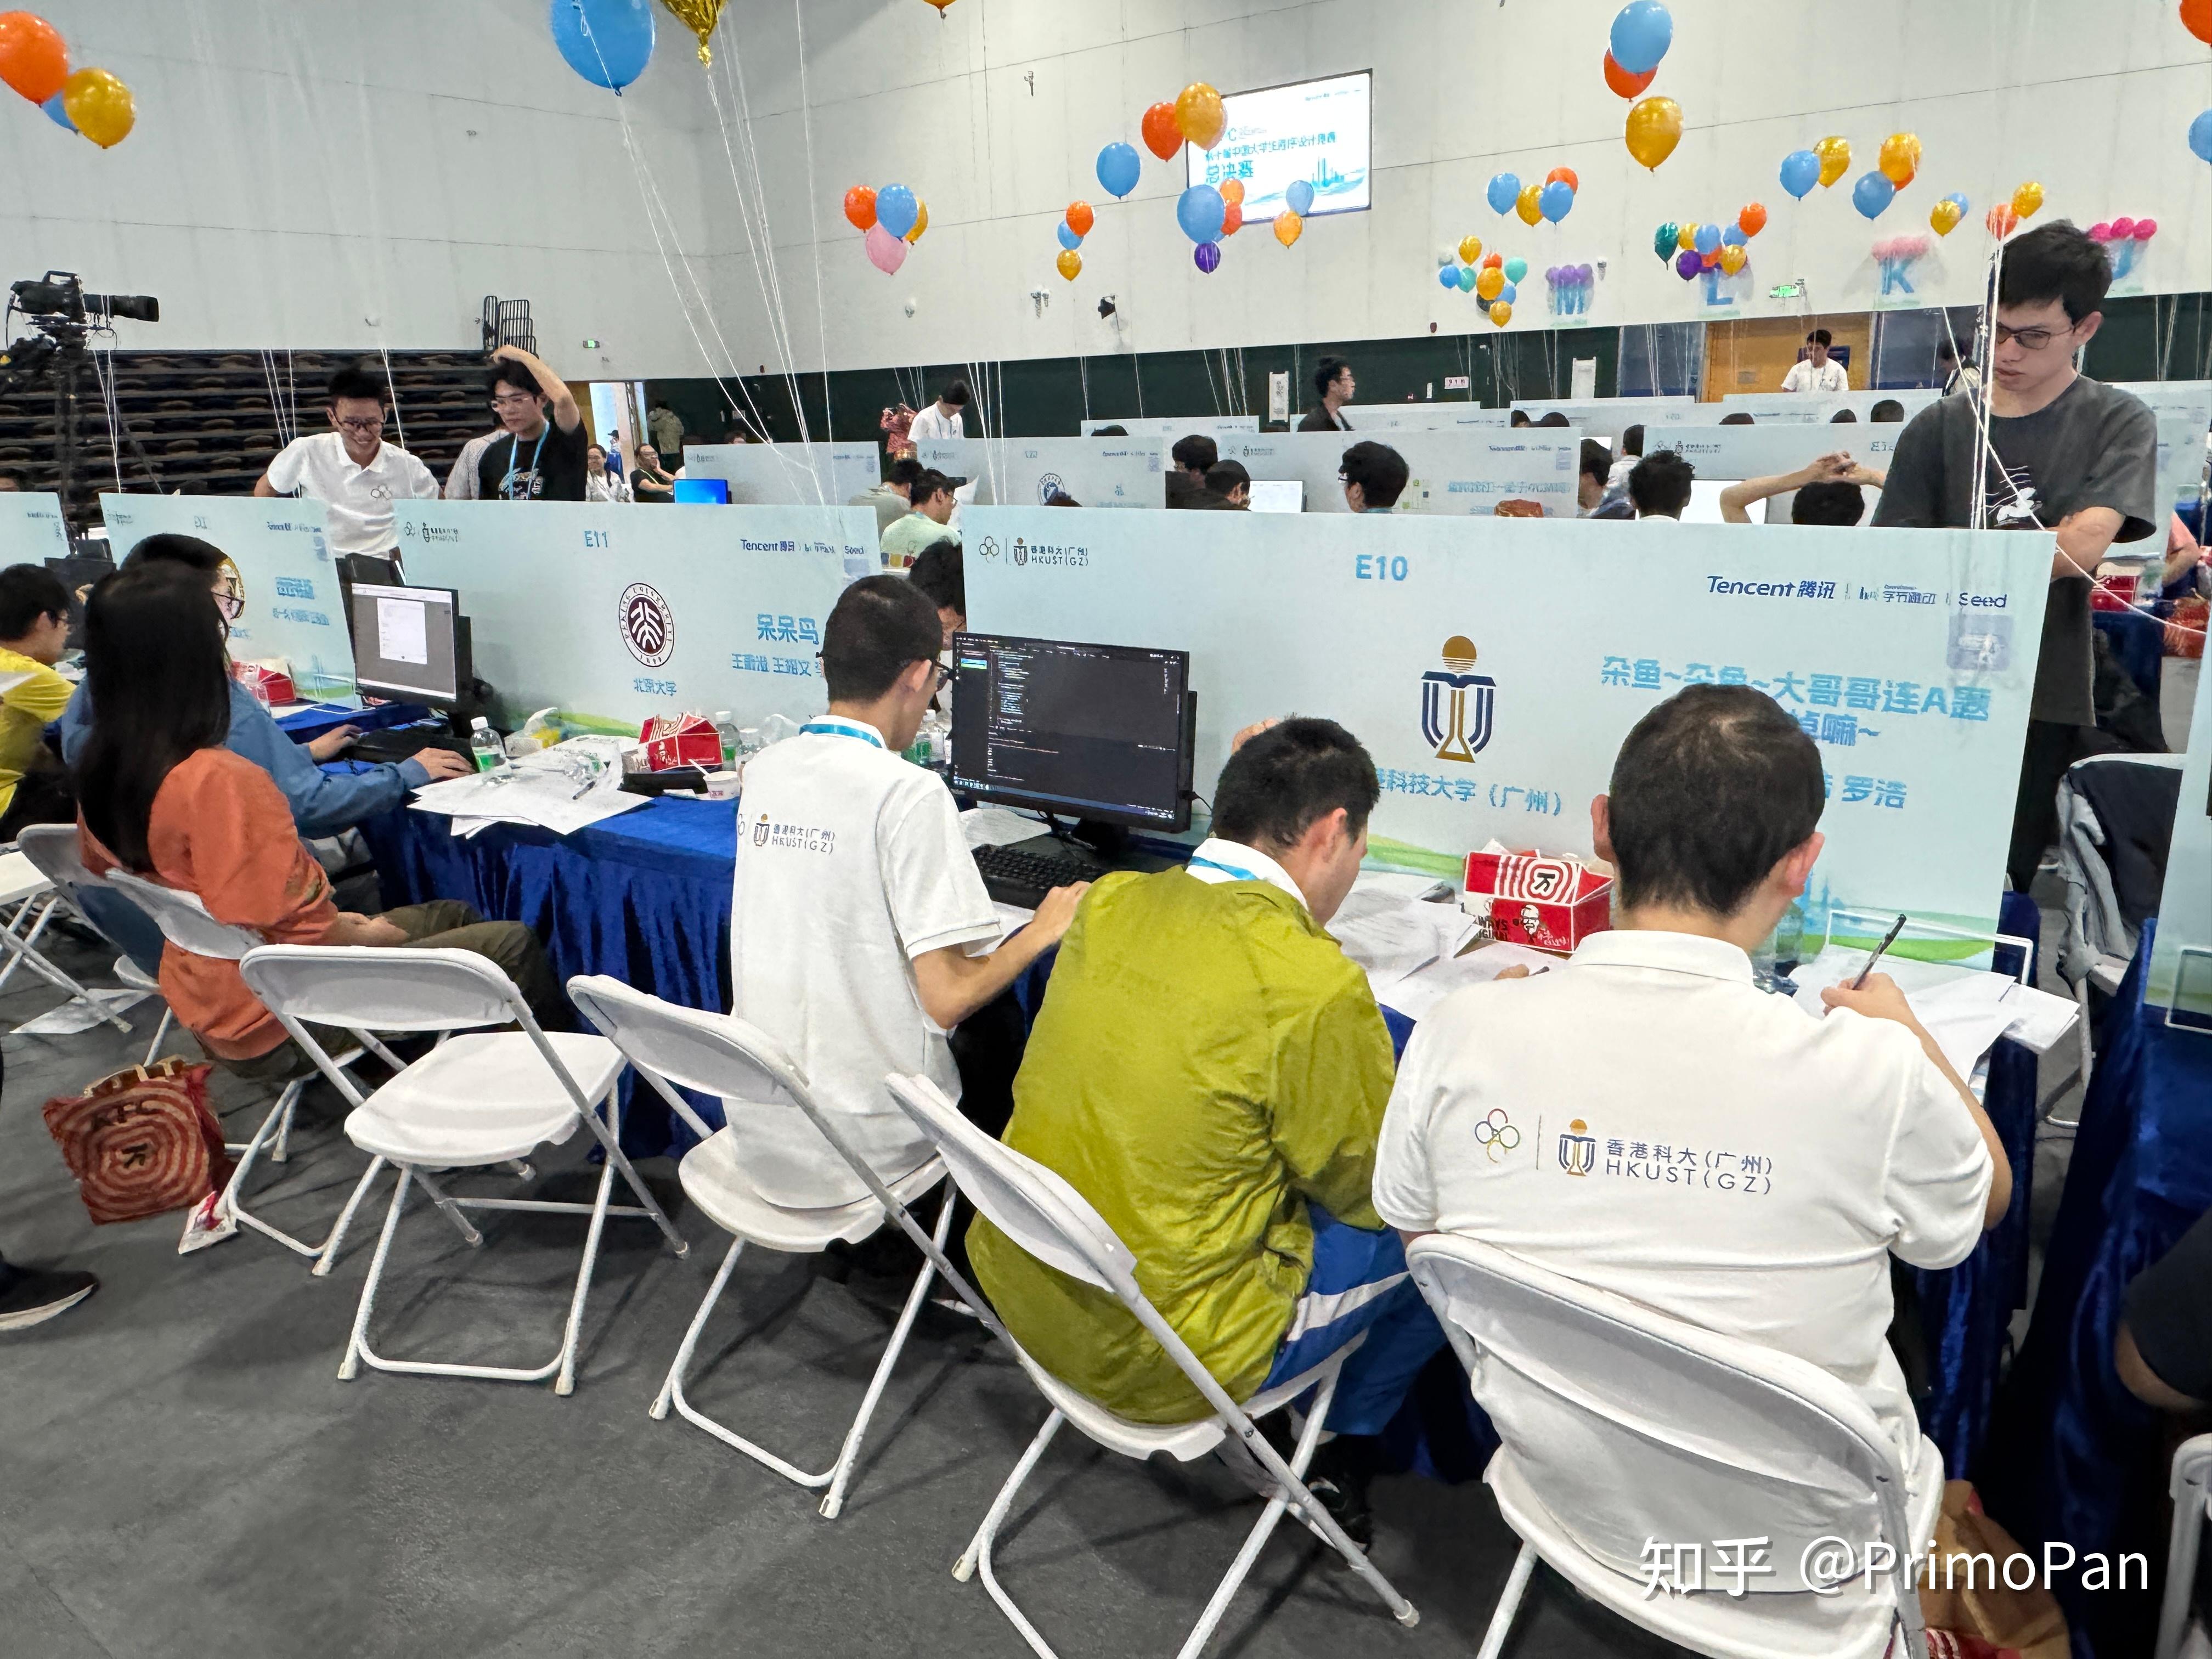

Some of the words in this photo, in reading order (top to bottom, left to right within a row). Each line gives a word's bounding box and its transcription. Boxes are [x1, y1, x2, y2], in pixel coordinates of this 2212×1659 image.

[584, 531, 608, 548] E11
[1356, 554, 1408, 581] E10
[1707, 575, 1796, 597] Tencent
[1796, 580, 1836, 599] 腾讯
[1958, 592, 2007, 608] Seed
[757, 613, 820, 645] 呆呆鸟
[633, 678, 678, 697] 北京大学
[1841, 774, 1908, 809] 罗浩
[1606, 1159, 1772, 1195] HKUST(GZ)
